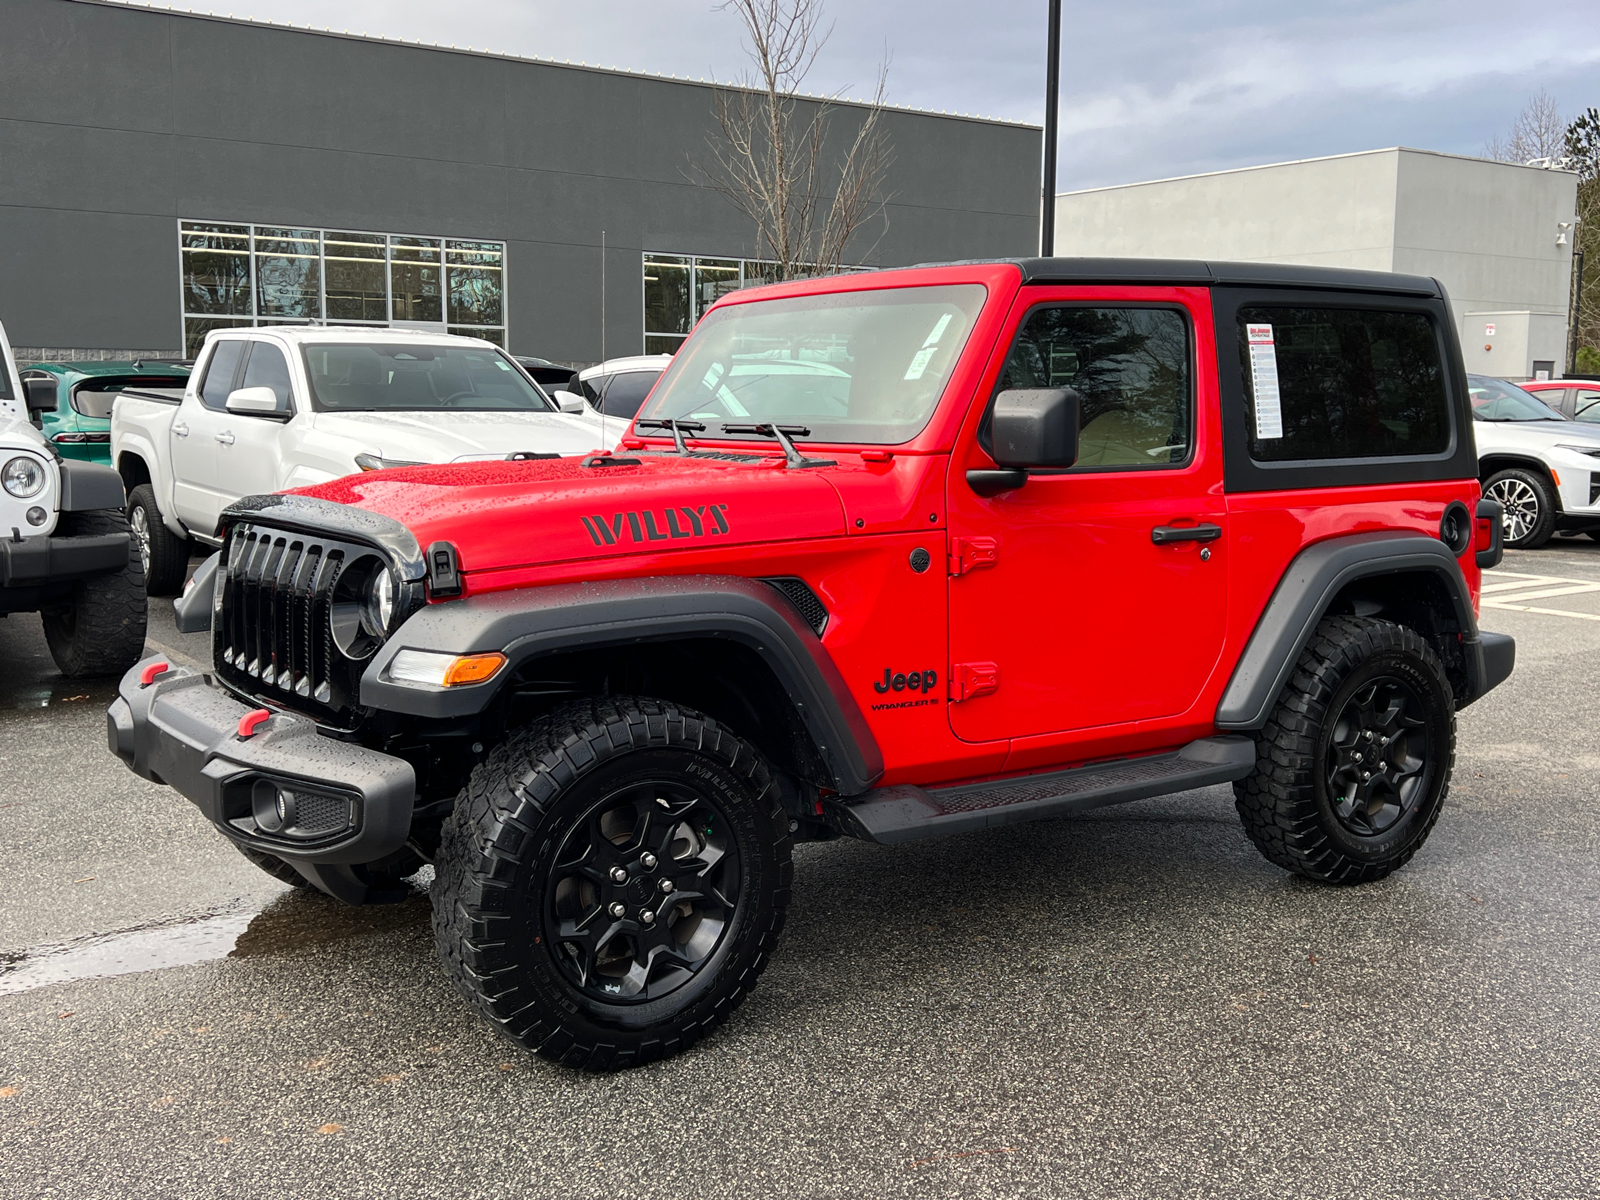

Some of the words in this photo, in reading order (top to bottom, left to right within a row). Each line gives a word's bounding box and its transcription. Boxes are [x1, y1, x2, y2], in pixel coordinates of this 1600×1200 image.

[580, 504, 730, 547] WILLYS
[874, 668, 937, 694] Jeep
[871, 699, 929, 711] WRANGLER
